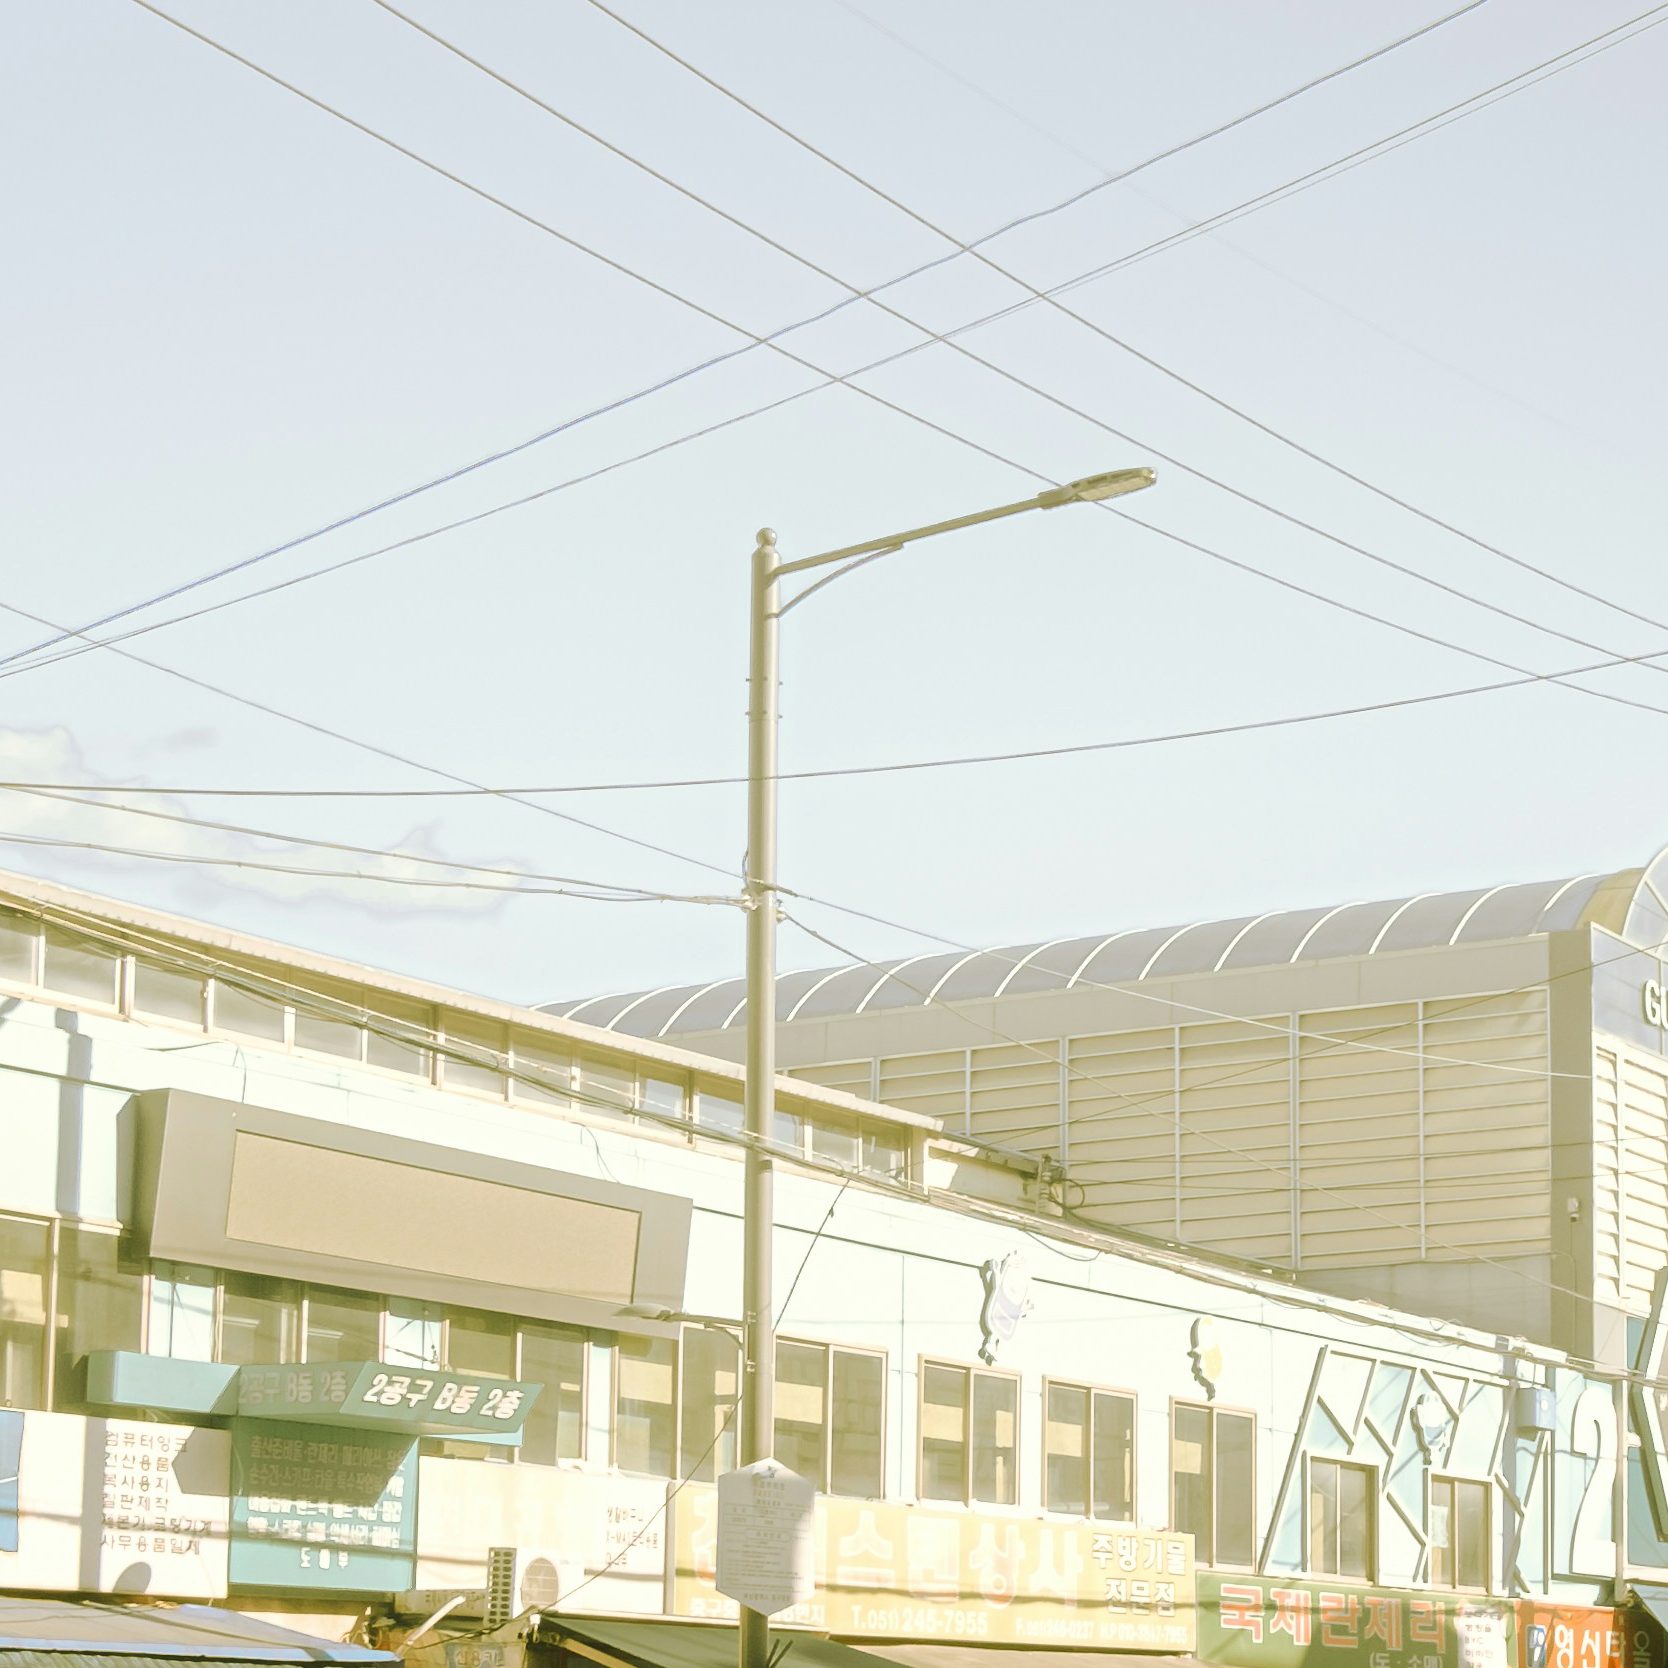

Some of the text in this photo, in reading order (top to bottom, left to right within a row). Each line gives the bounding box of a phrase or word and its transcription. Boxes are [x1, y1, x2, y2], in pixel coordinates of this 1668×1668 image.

[362, 1373, 525, 1419] 2공구 B동 2층
[1091, 1532, 1187, 1575] 주방기물
[1105, 1576, 1176, 1617] 전문점
[1220, 1582, 1446, 1654] 국제란제리
[902, 1609, 988, 1636] 245-7955
